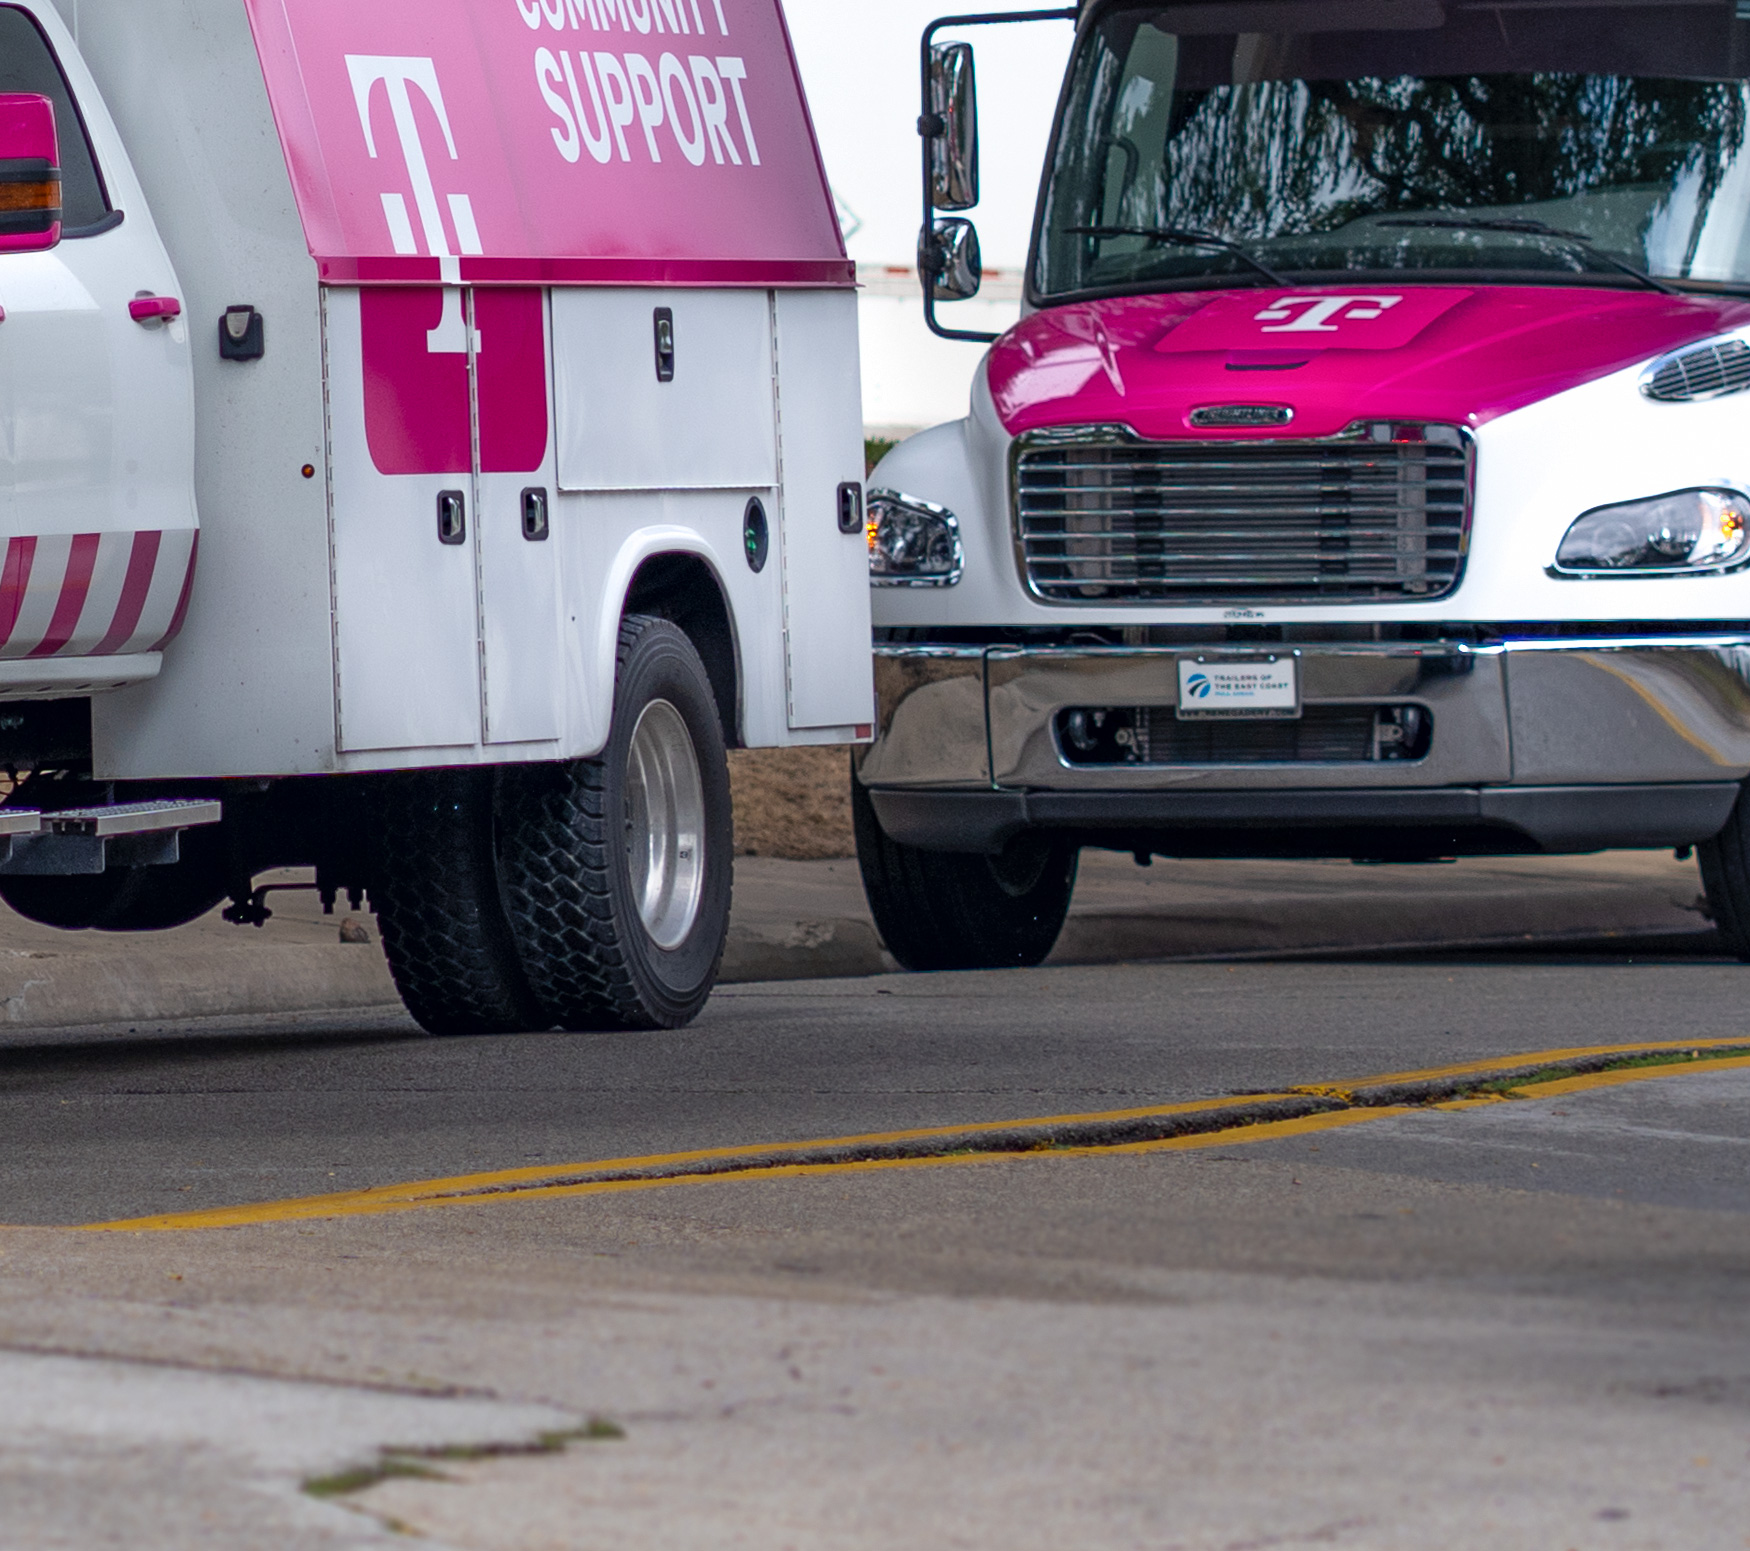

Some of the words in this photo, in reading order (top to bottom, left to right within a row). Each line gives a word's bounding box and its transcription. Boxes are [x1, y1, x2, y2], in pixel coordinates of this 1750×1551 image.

[534, 46, 760, 166] SUPPORT
[344, 54, 484, 353] T
[1254, 294, 1403, 333] T
